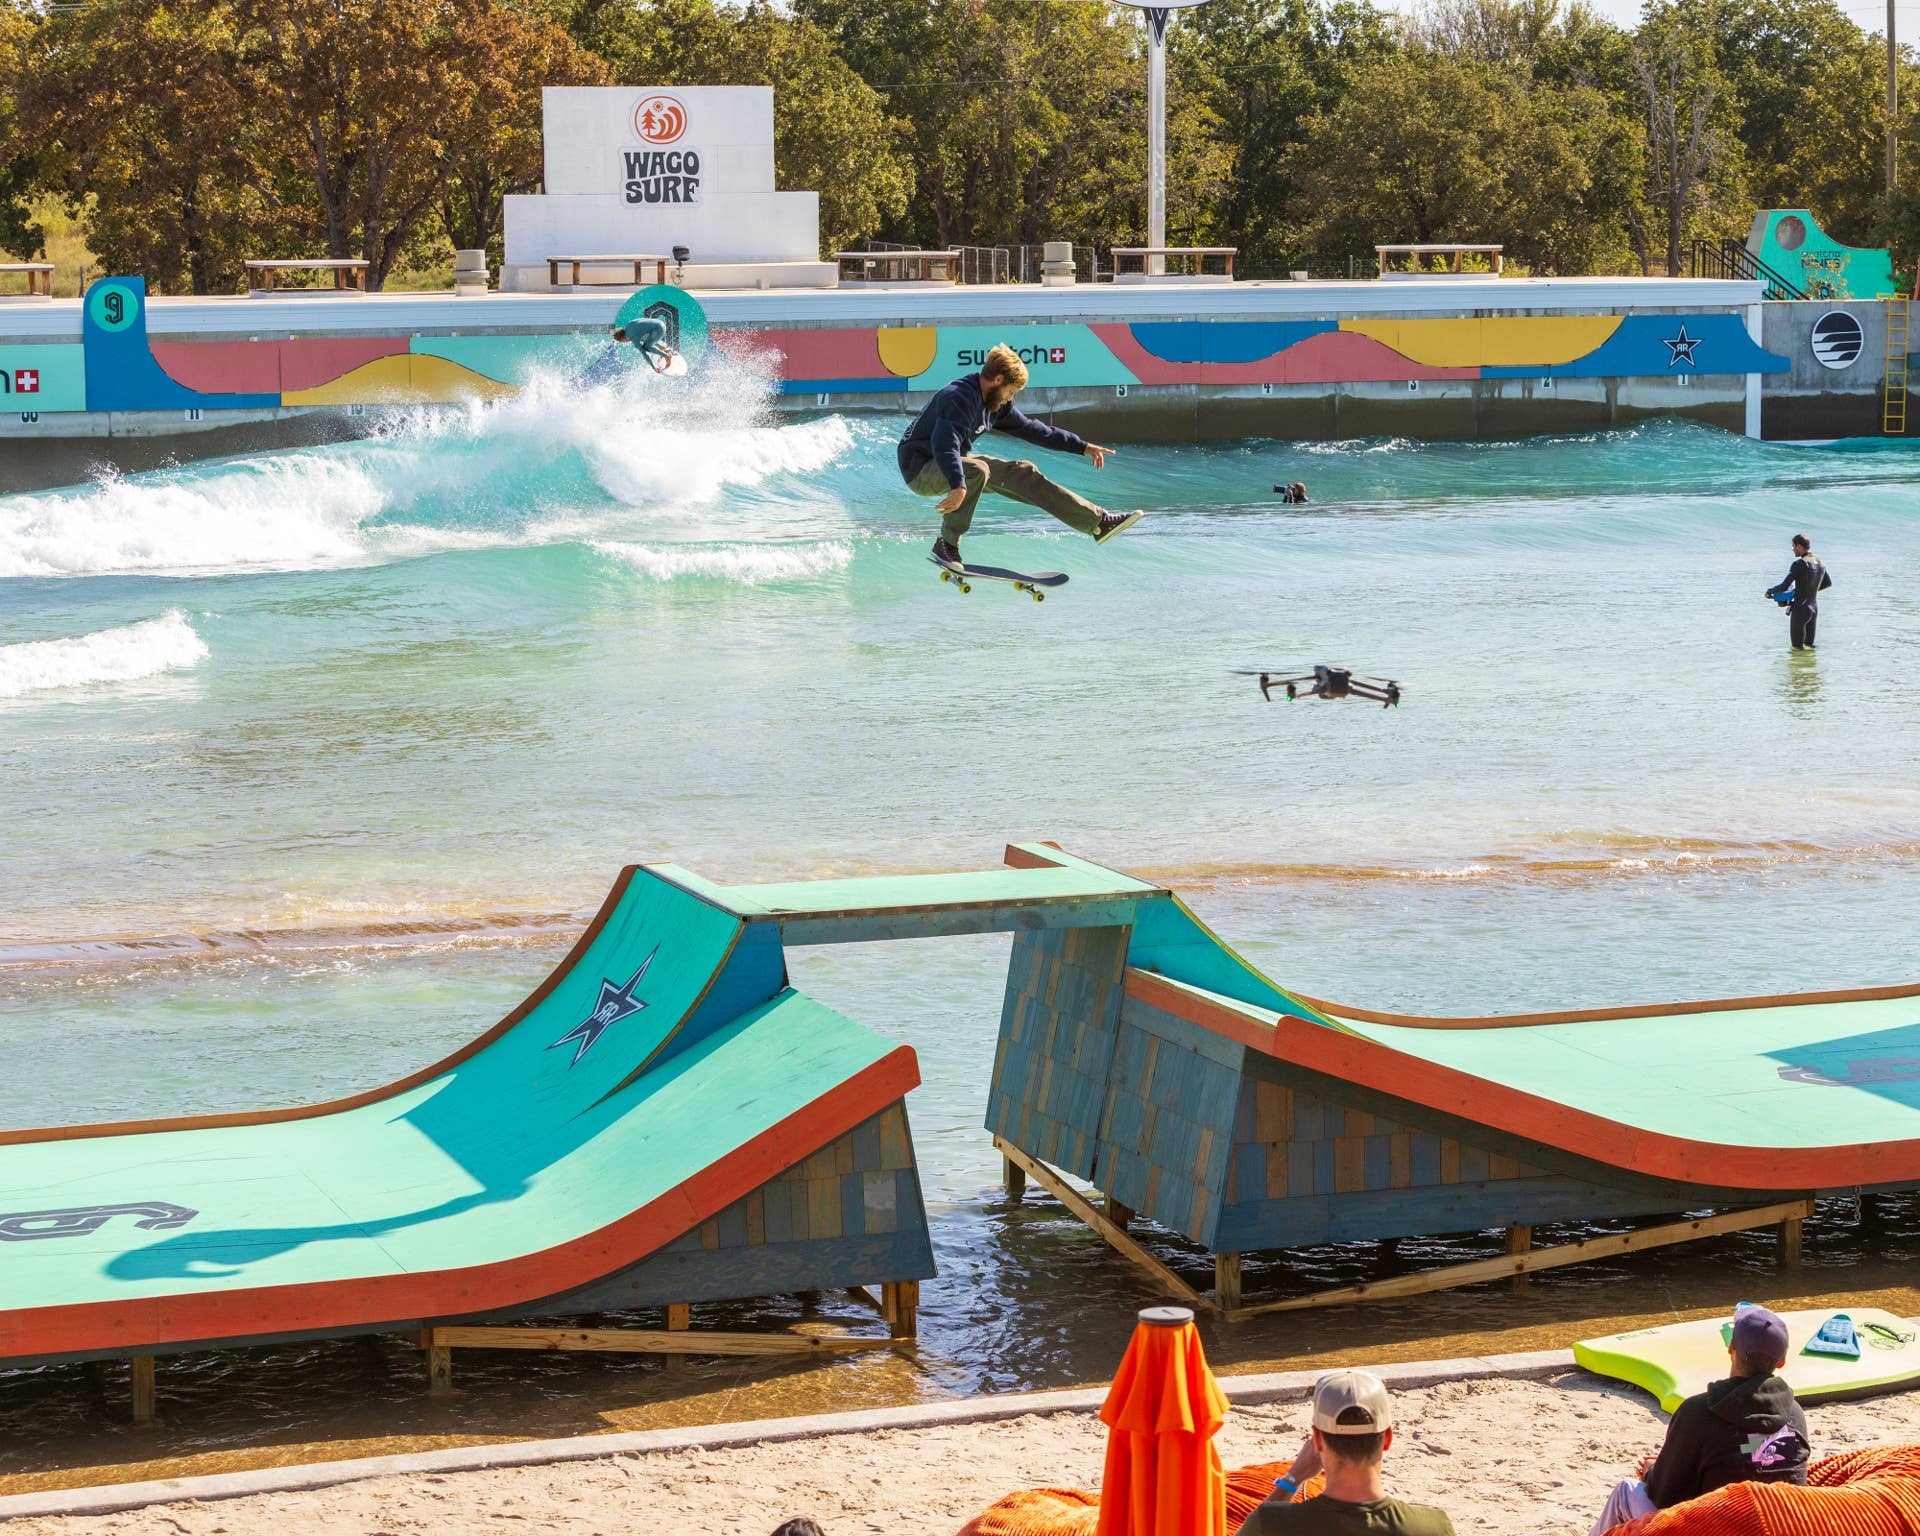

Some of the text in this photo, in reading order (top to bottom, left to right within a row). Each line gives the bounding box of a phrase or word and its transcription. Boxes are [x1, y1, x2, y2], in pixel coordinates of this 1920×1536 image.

[623, 151, 700, 179] WACO
[625, 176, 700, 203] SURF
[1263, 383, 1271, 394] 4
